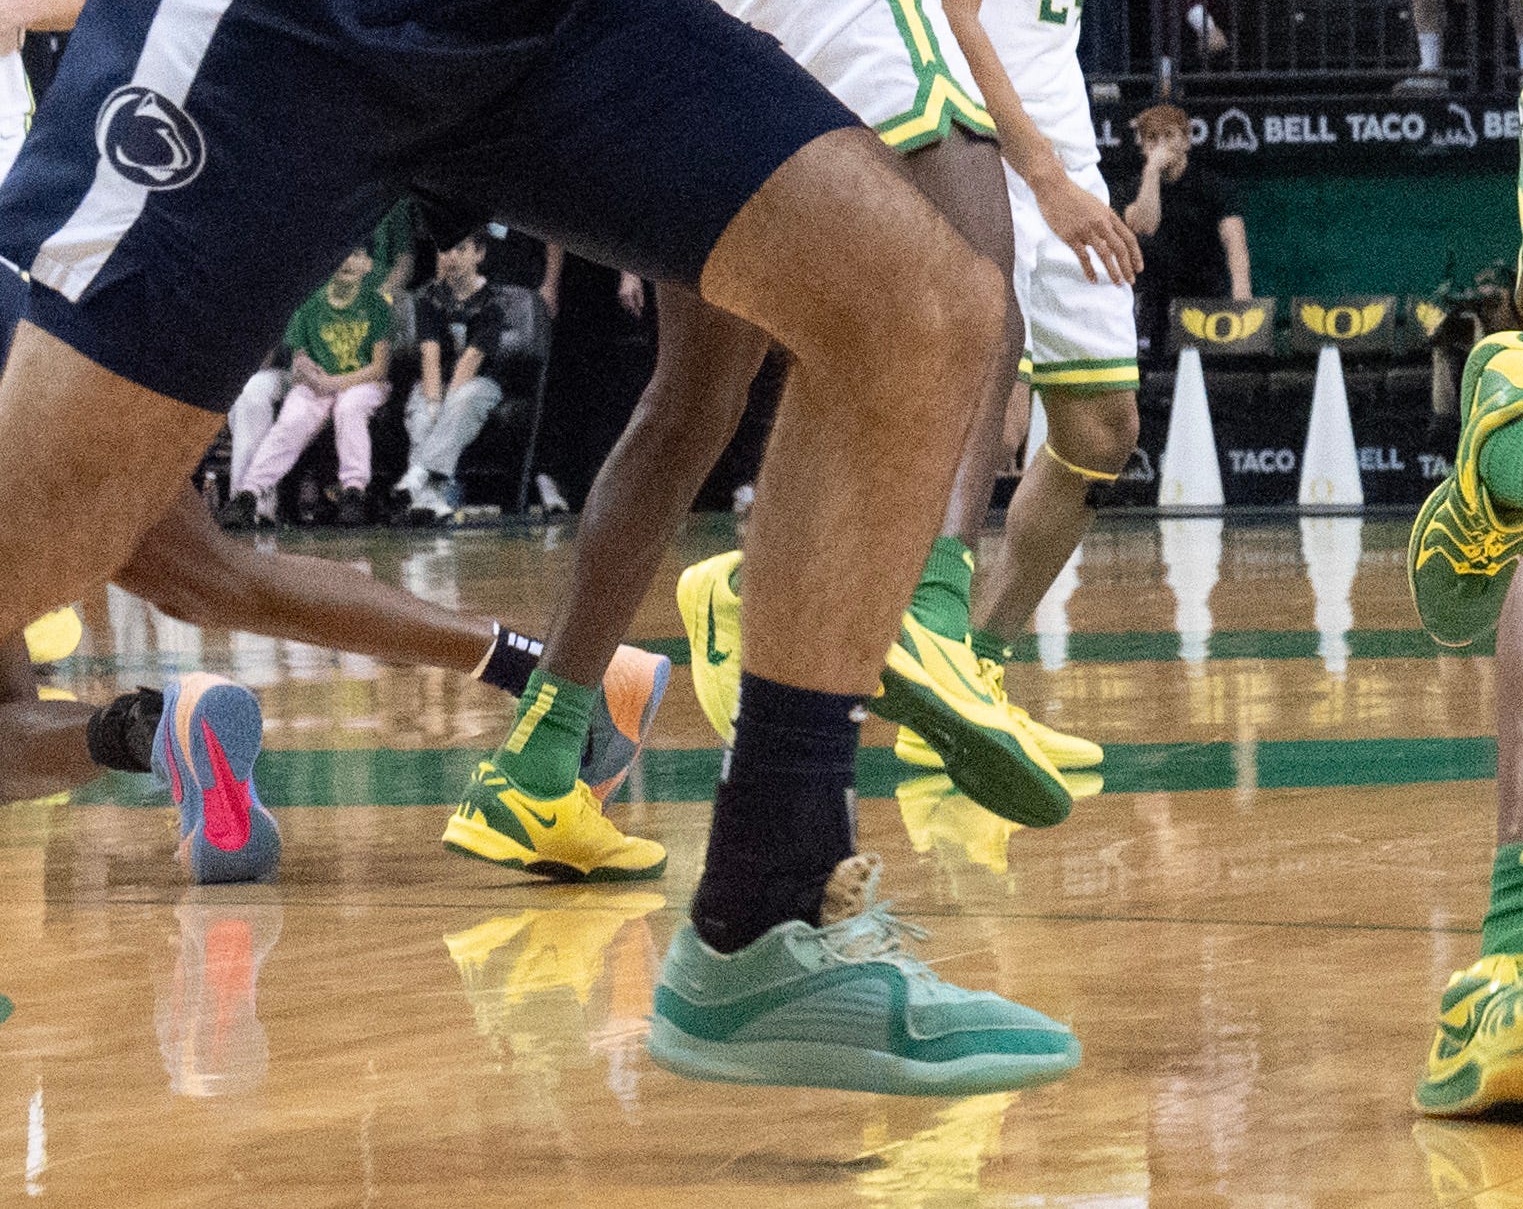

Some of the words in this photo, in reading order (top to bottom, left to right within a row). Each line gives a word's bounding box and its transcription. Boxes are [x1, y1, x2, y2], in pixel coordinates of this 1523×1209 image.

[1263, 115, 1337, 143] BELL
[1346, 113, 1426, 142] TACO
[1483, 110, 1521, 140] BE
[1228, 448, 1296, 474] TACO
[1359, 447, 1405, 471] ELL
